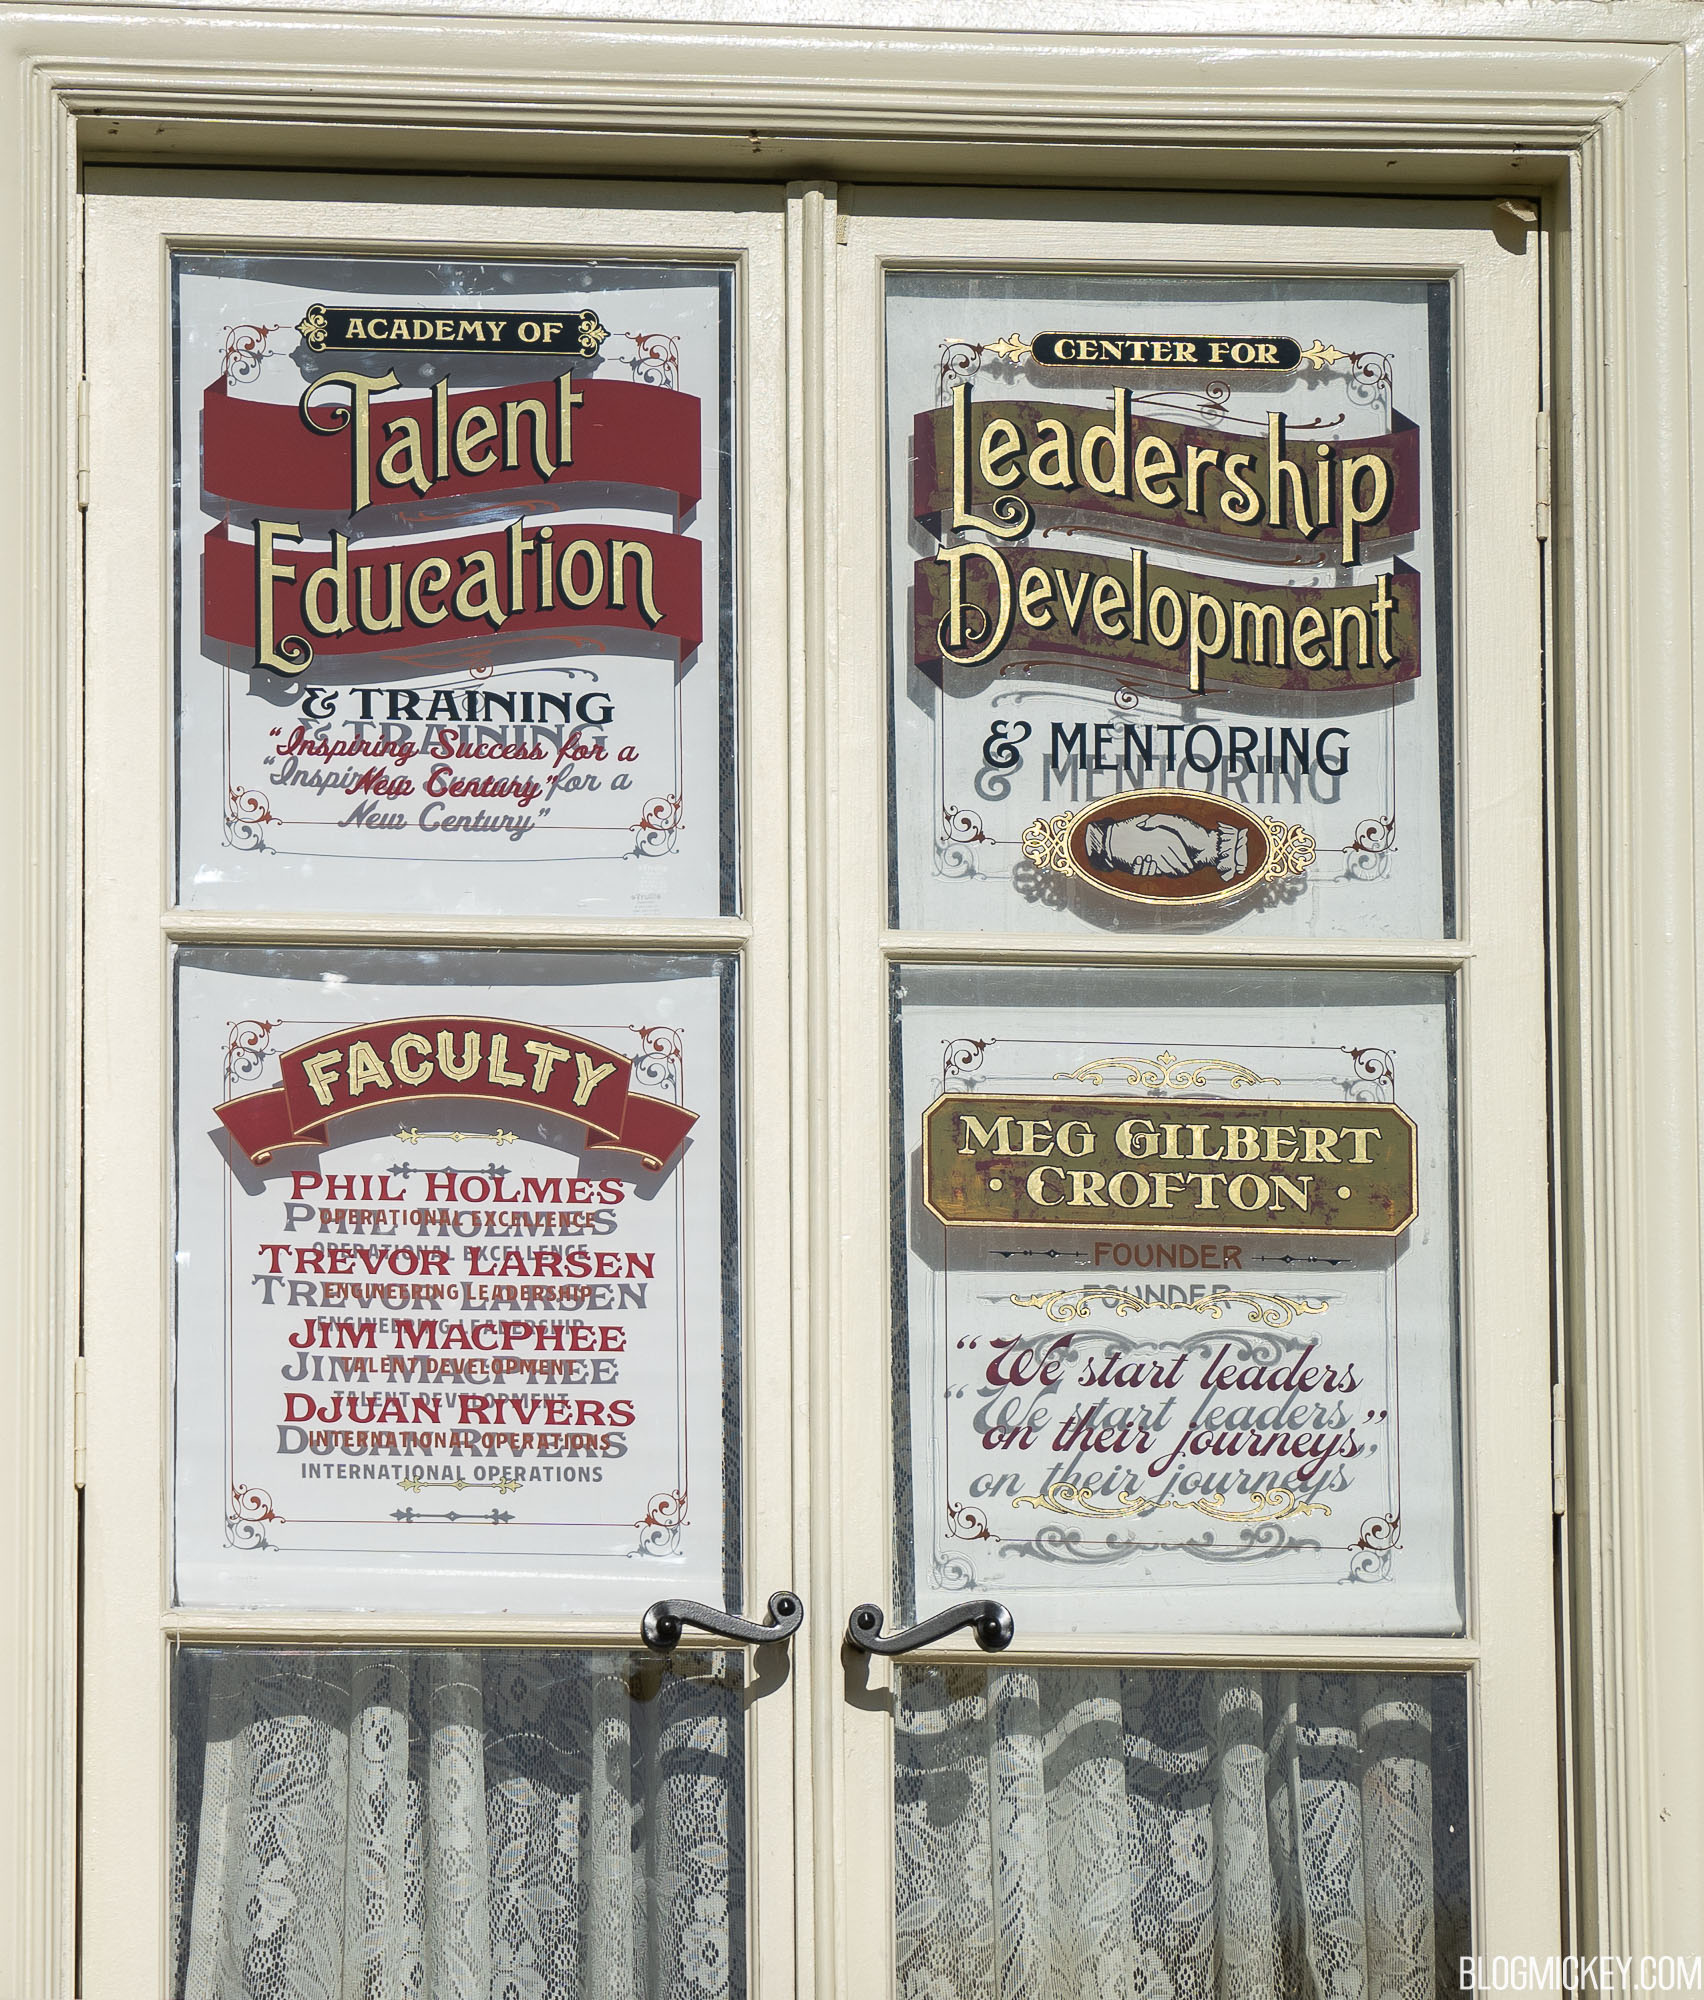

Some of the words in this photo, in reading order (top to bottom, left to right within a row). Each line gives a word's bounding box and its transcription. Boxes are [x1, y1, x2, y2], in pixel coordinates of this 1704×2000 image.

[345, 318, 507, 342] ACADEMY
[517, 321, 564, 343] OF
[1054, 338, 1199, 363] CENTER
[1207, 341, 1280, 365] FOR
[301, 367, 584, 517] Talent
[950, 382, 1394, 567] Leadership
[252, 515, 664, 677] Education
[936, 541, 1401, 693] Development
[301, 687, 339, 719] &
[349, 688, 615, 725] TRAINING
[429, 729, 548, 761] Success
[552, 730, 608, 768] for
[617, 743, 640, 762] a
[982, 719, 1032, 769] &
[1050, 722, 1351, 776] MENTORING
[345, 767, 416, 798] New
[301, 1029, 617, 1107] FACULTY
[958, 1115, 1096, 1158] MEG
[1114, 1119, 1382, 1164] GILBERT
[290, 1170, 407, 1201] PHIL
[425, 1173, 625, 1204] HOLMES
[1025, 1165, 1314, 1213] CROFTON
[320, 1209, 464, 1226] OPERATIONAL
[472, 1210, 595, 1228] EXCELLENCE
[258, 1244, 451, 1276] TREVOR
[468, 1246, 656, 1279] LARSEN
[1094, 1241, 1243, 1270] FOUNDER
[325, 1284, 459, 1300] ENGINEERING
[467, 1284, 593, 1302] LEADERSHIP
[288, 1319, 378, 1349] JIM
[394, 1319, 627, 1352] MACPHEE
[342, 1357, 418, 1373] TALENT
[427, 1358, 577, 1375] DEVELOPMENT
[1077, 1351, 1194, 1389] start
[1200, 1343, 1364, 1393] leaders
[283, 1392, 441, 1424] DJUAN
[458, 1395, 636, 1427] RIVERS
[309, 1430, 474, 1449] INTERNATIONAL
[481, 1432, 611, 1450] OPERATIONS
[981, 1423, 1045, 1451] on
[1050, 1405, 1160, 1455] their
